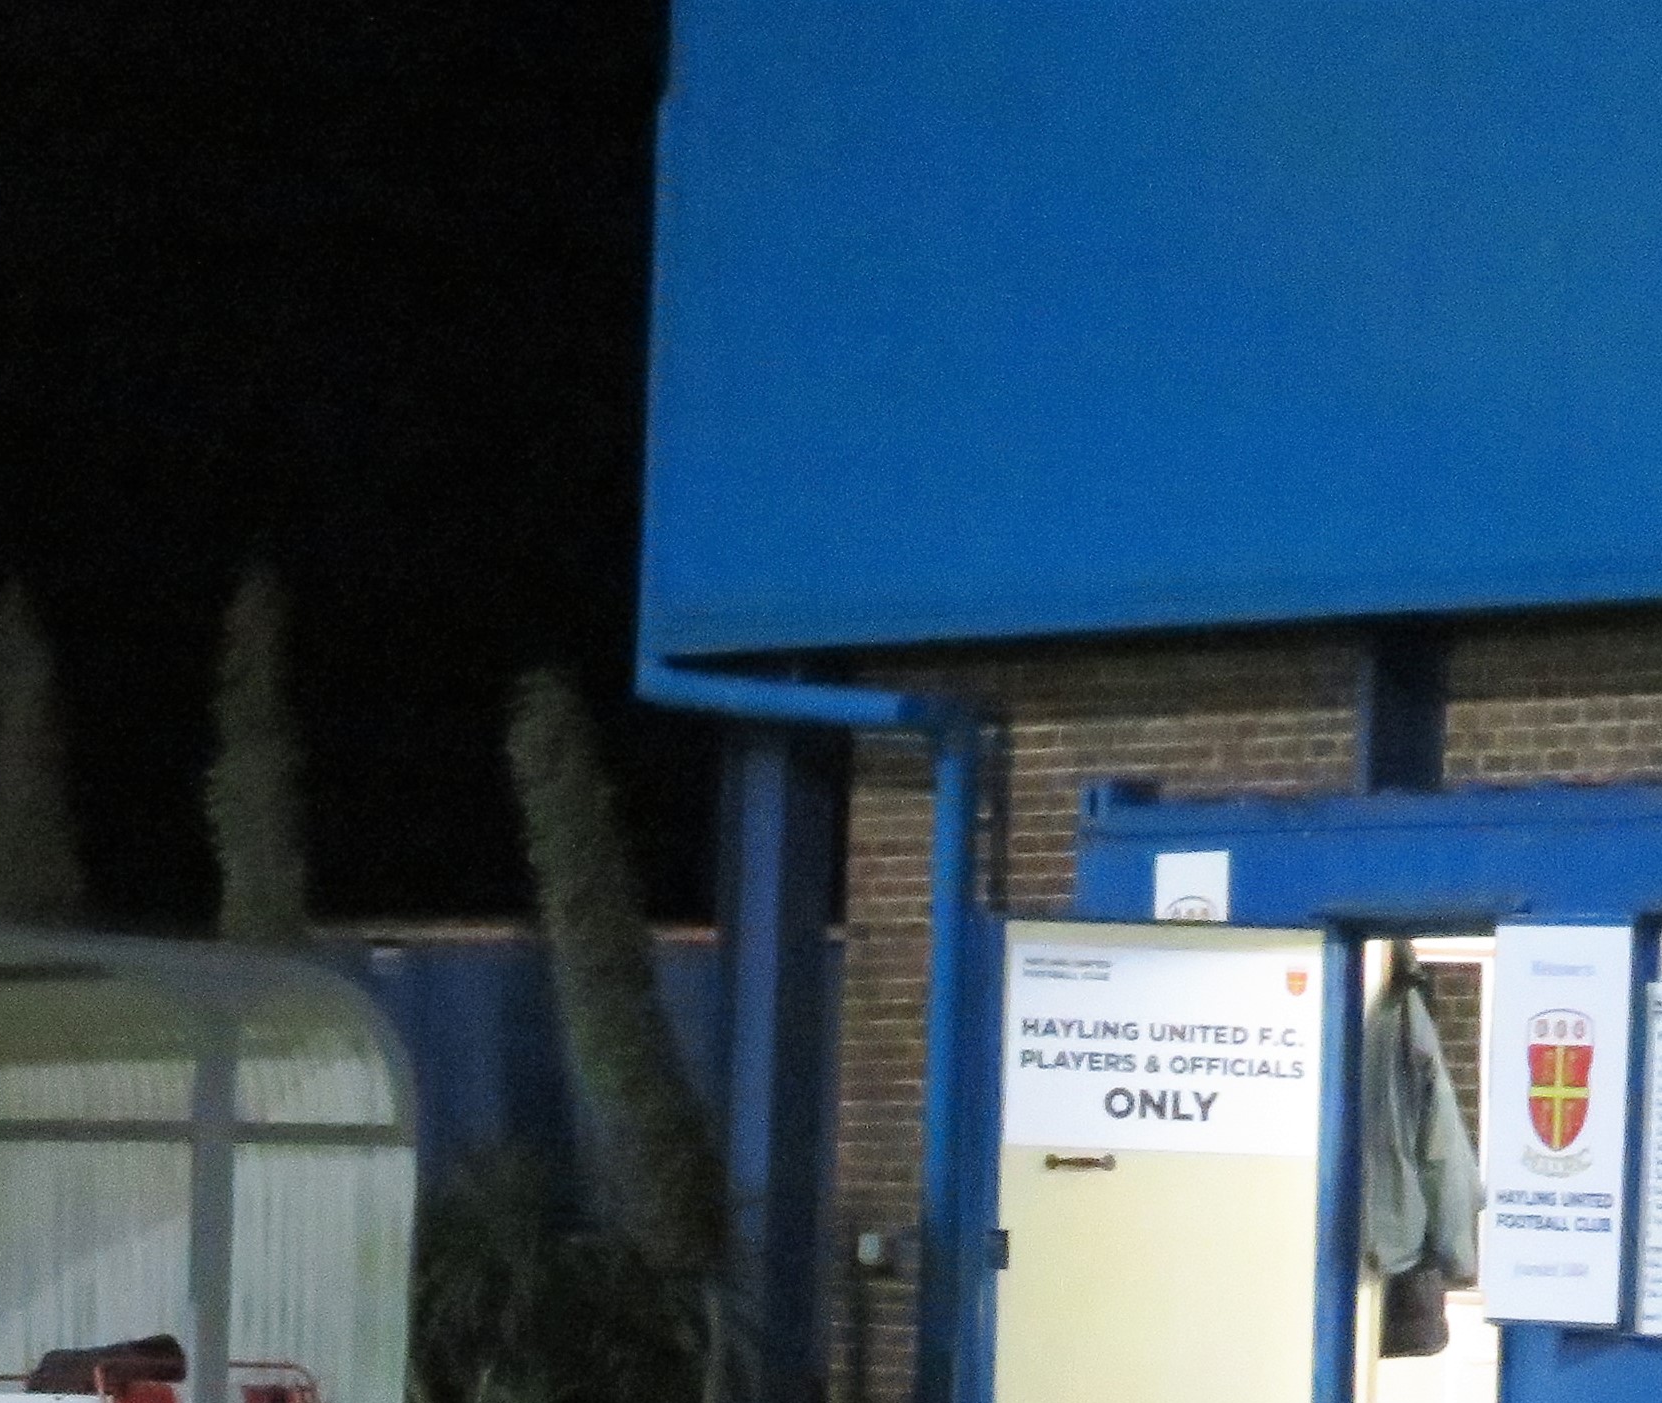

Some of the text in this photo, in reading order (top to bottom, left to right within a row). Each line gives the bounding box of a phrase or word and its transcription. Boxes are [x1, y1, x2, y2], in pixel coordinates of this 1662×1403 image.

[1020, 1017, 1305, 1048] HAYLING UNITED F.C.
[1019, 1048, 1304, 1080] PLAYERS & OFFICIALS
[1103, 1086, 1220, 1122] ONLY
